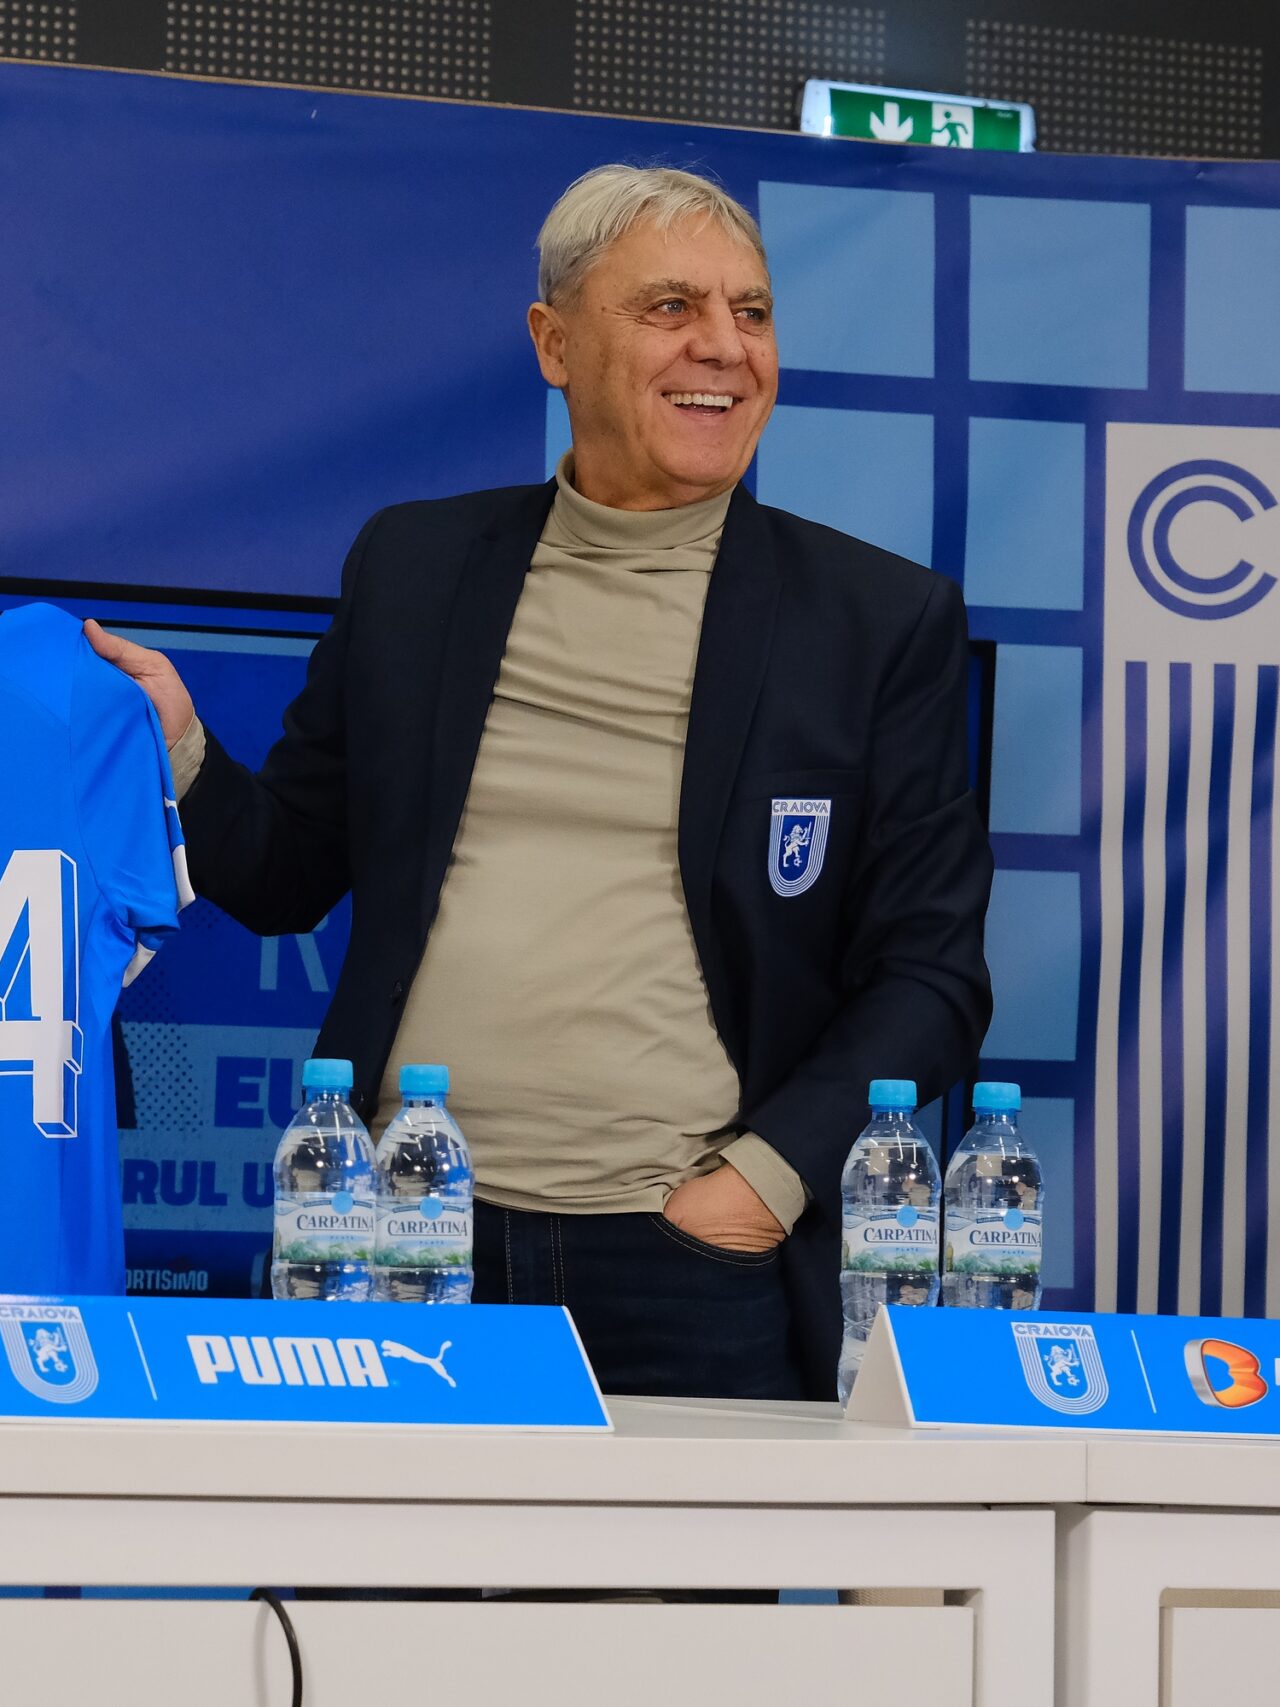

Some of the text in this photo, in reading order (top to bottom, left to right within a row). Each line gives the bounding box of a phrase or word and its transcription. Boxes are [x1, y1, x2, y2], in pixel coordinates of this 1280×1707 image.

[773, 801, 828, 813] CRAIOVA
[296, 1213, 375, 1233] CARPATINA
[387, 1219, 468, 1237] CARPATINA
[863, 1227, 938, 1245] CARPATINA
[1014, 1323, 1092, 1337] CRAIOVA
[186, 1334, 390, 1388] PUMA
